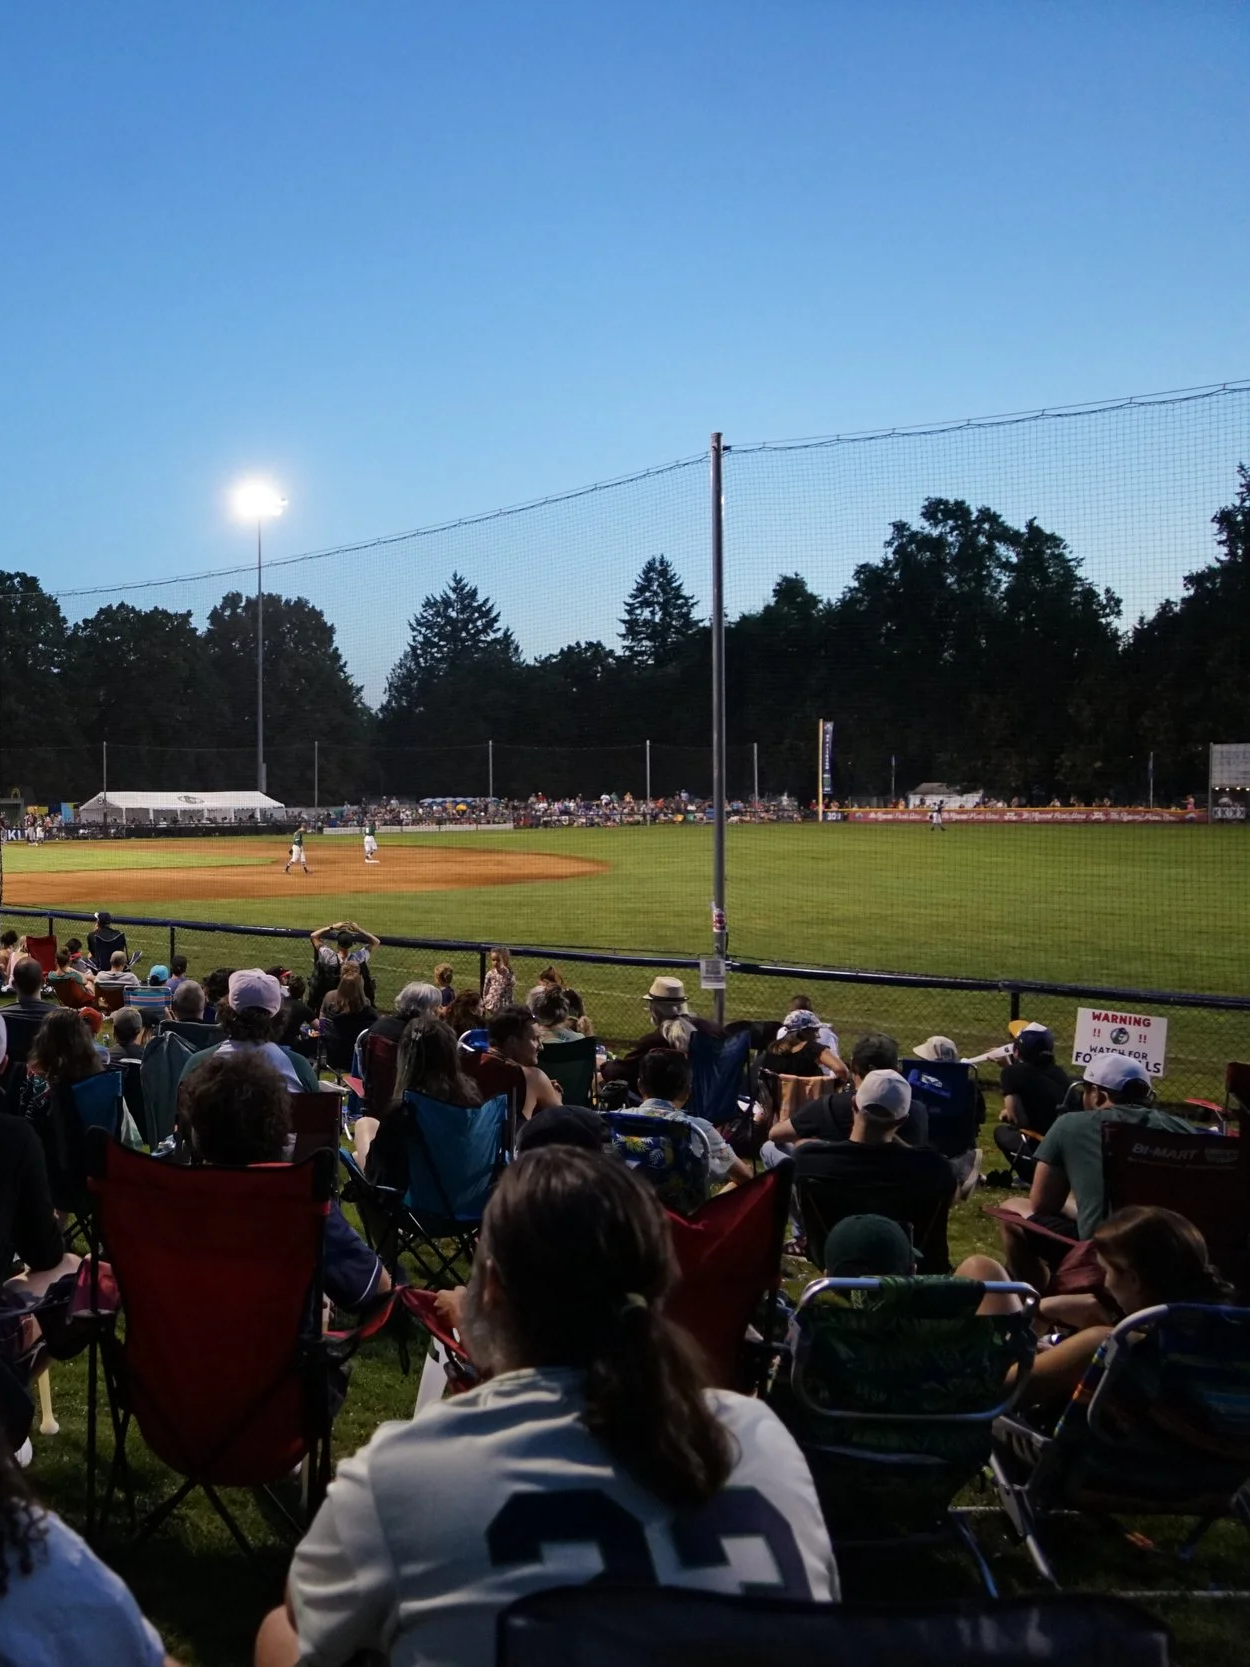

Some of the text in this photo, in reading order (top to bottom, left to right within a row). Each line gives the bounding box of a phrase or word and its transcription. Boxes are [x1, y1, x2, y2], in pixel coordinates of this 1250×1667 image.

[1092, 1012, 1151, 1027] WARNING
[1128, 1051, 1148, 1060] FOR
[1132, 1142, 1199, 1161] BI-MART
